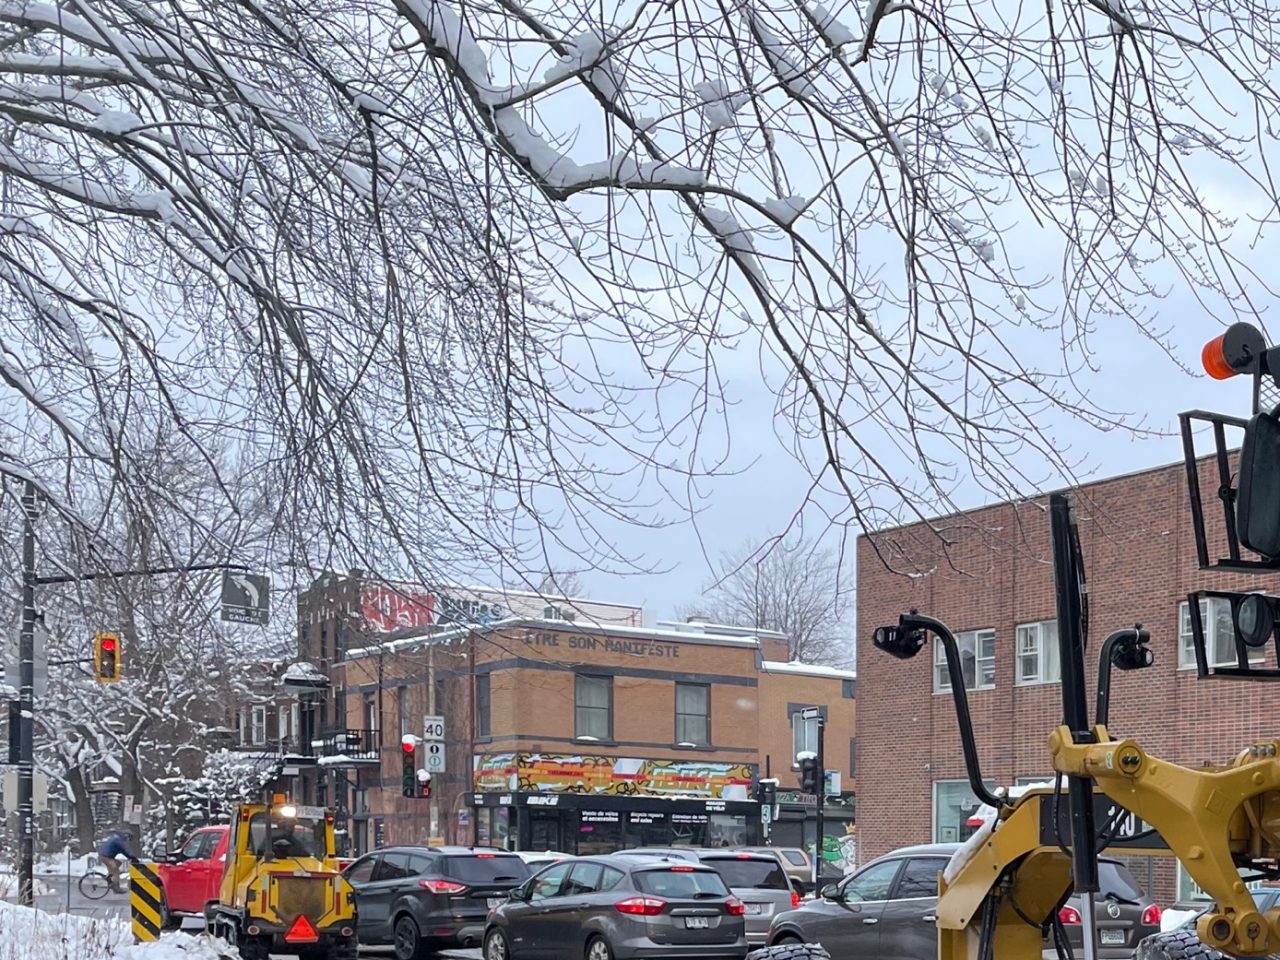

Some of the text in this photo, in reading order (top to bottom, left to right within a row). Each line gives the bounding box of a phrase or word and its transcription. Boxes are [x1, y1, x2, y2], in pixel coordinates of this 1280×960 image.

[568, 636, 596, 650] SON
[605, 639, 680, 658] MANIFESTE
[425, 724, 443, 737] 40
